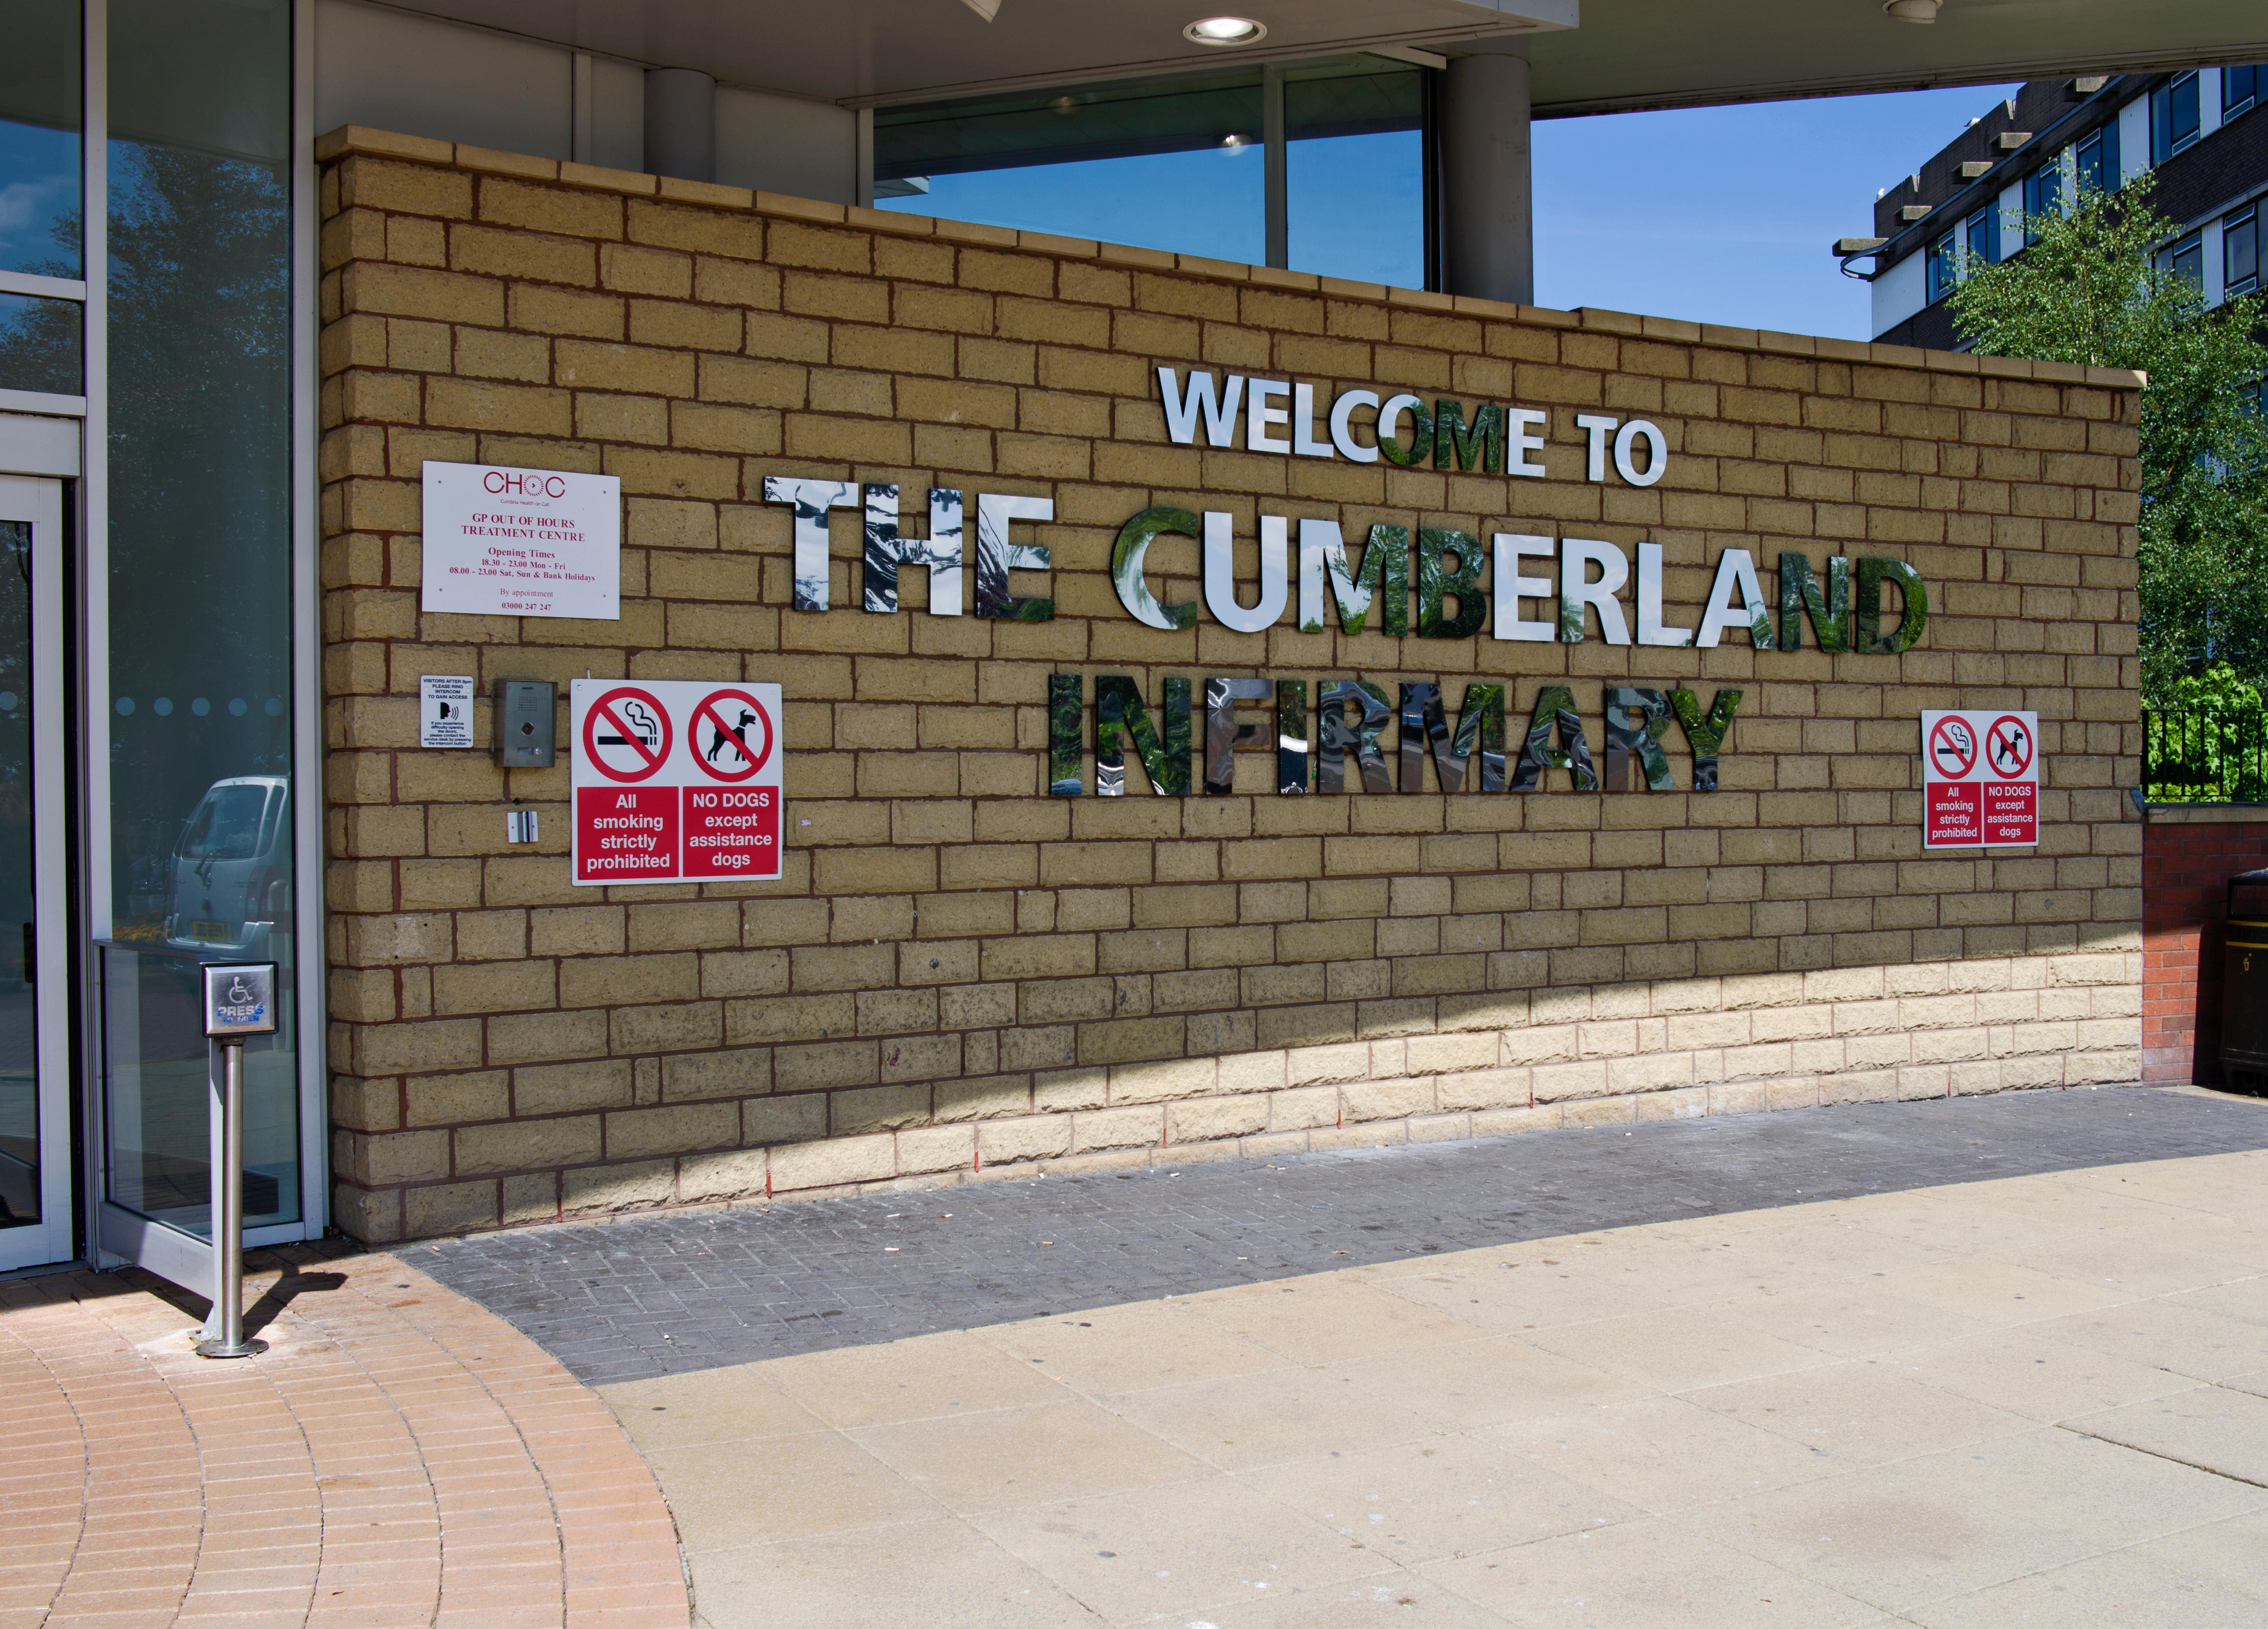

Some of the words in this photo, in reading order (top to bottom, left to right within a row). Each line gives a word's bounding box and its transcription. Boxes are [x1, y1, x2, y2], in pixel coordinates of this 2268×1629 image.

[1158, 366, 1545, 478] WELCOME
[1577, 414, 1667, 487] TO
[472, 513, 487, 523] GP
[491, 514, 515, 524] OUT
[519, 516, 533, 525] OF
[537, 517, 575, 528] HOURS
[462, 525, 535, 538] TREATMENT
[539, 530, 585, 542] CENTRE
[488, 547, 526, 558] Opening
[529, 549, 555, 558] Times
[762, 476, 1054, 621] THE
[1112, 507, 1928, 654] CUMBERLAND
[565, 573, 595, 582] Holidays
[500, 588, 509, 597] By
[512, 589, 553, 598] appointment
[1049, 674, 1745, 796] INFIRMARY
[1947, 787, 1959, 797] All
[1989, 787, 2003, 796] NO
[2005, 786, 2031, 796] DOGS
[616, 794, 636, 808] All
[693, 794, 718, 807] NO
[723, 793, 769, 807] DOGS
[1936, 801, 1973, 812] smoking
[1996, 800, 2025, 811] except
[594, 814, 663, 831] smoking
[705, 813, 758, 829] except
[1940, 814, 1969, 825] strictly
[1988, 813, 2033, 823] assistance
[689, 832, 772, 847] assistance
[1932, 827, 1977, 840] prohibited
[2000, 827, 2021, 838] dogs
[601, 834, 657, 851] strictly
[587, 853, 670, 872] prohibited
[712, 852, 750, 868] dogs
[217, 1004, 264, 1016] PRESS
